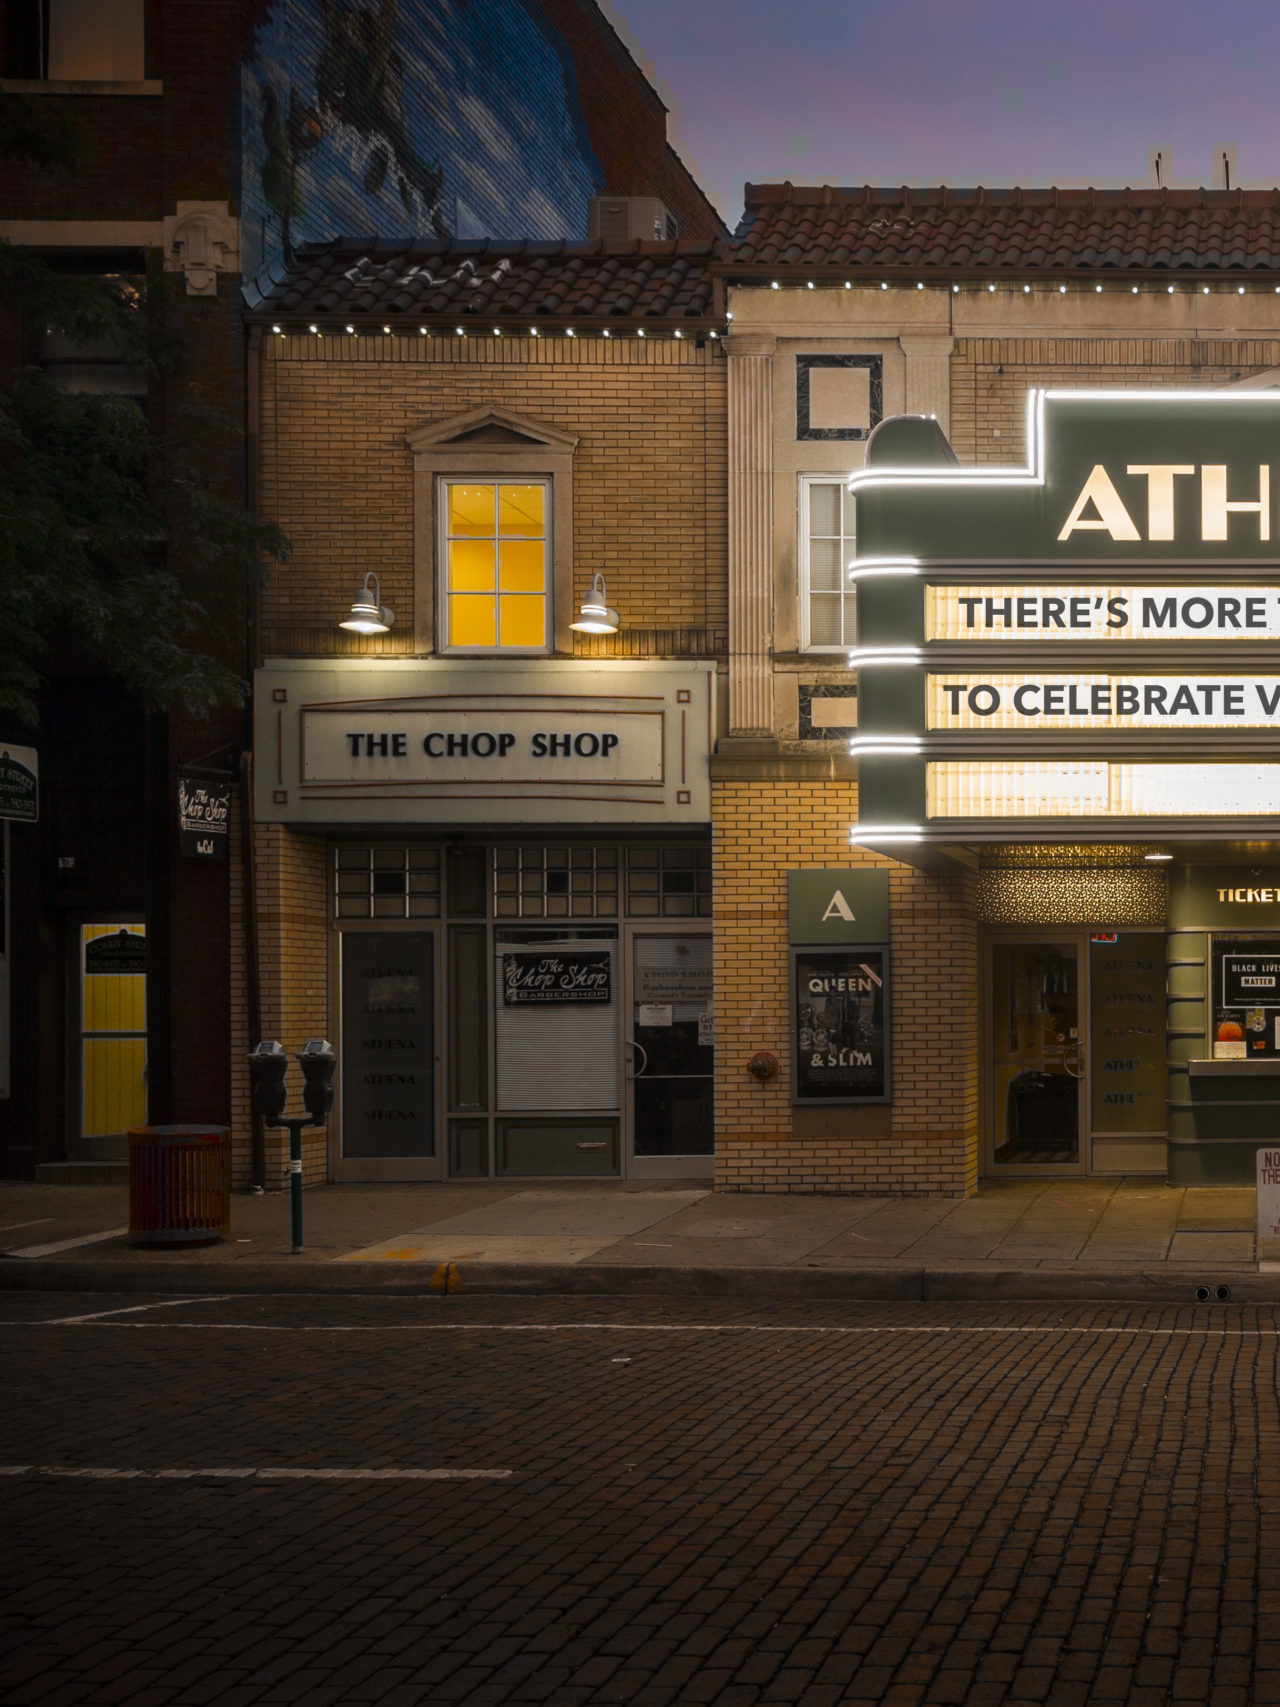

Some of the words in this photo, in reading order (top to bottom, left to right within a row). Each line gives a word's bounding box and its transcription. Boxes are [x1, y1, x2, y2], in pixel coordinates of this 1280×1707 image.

[958, 597, 1130, 629] THERE'S
[1142, 597, 1268, 629] MORE
[943, 684, 1001, 716] TO
[1013, 684, 1245, 716] CELEBRATE
[346, 733, 407, 757] THE
[423, 733, 516, 758] CHOP
[531, 733, 619, 758] SHOP
[822, 889, 857, 922] A
[538, 958, 565, 973] The
[1231, 964, 1257, 973] BLACK
[508, 965, 555, 991] Chop
[560, 964, 608, 989] Shop
[808, 977, 873, 993] QUEEN
[1244, 977, 1274, 986] MATTER
[362, 1039, 416, 1049] ATHENA
[810, 1052, 824, 1067] &
[827, 1050, 873, 1067] SLIM
[362, 1074, 417, 1085] ATHENA
[361, 1110, 417, 1120] ATHENA
[1264, 1151, 1280, 1168] NO
